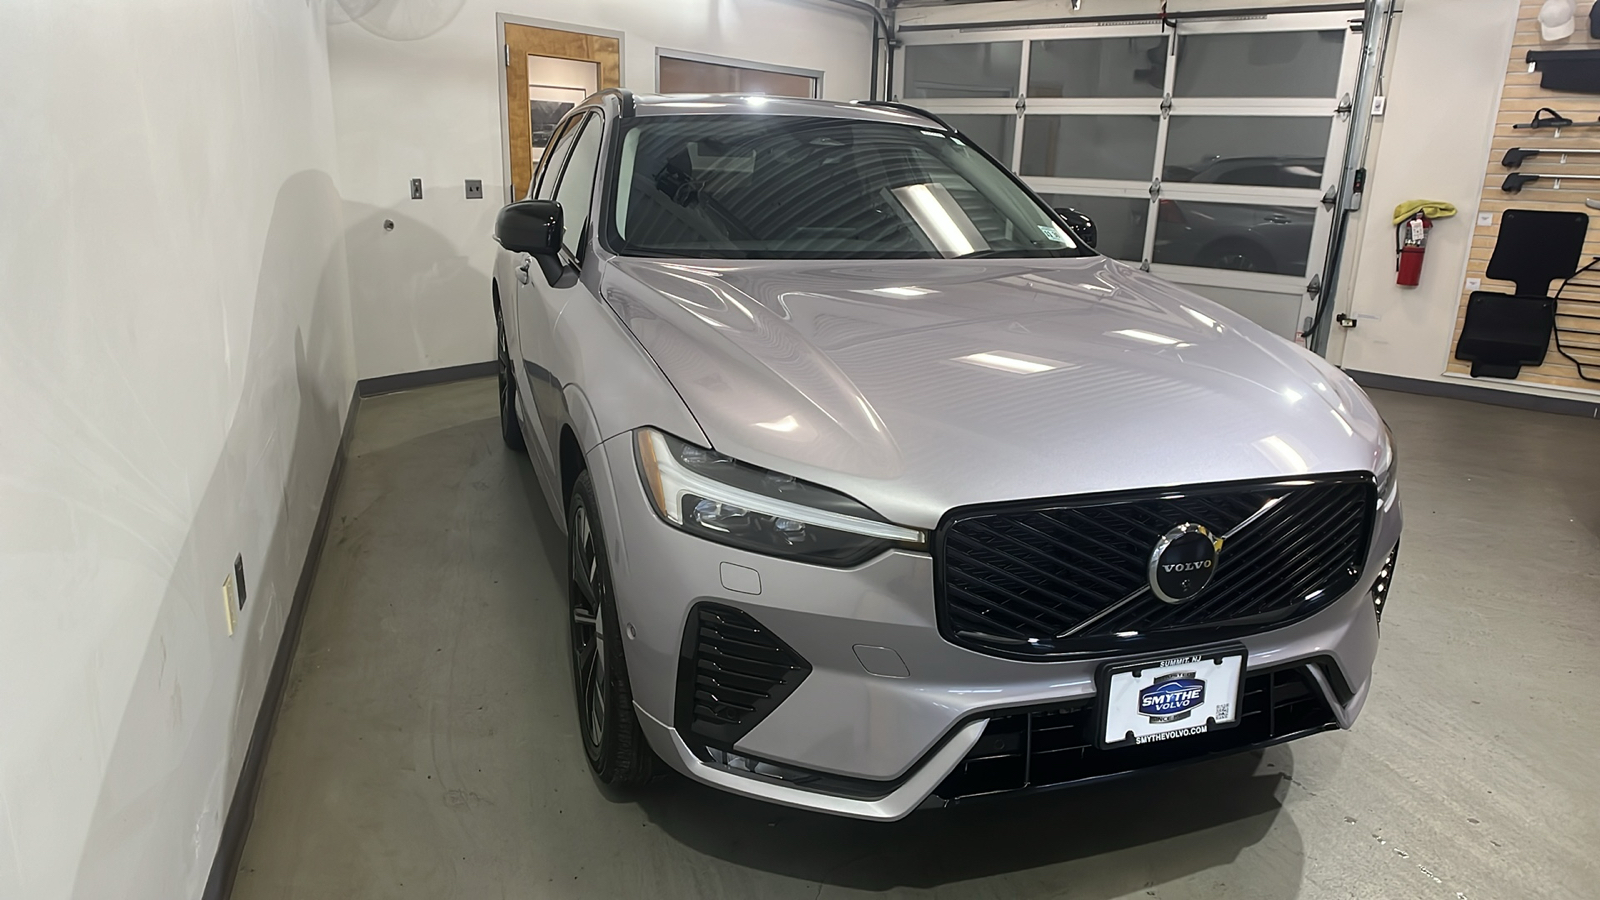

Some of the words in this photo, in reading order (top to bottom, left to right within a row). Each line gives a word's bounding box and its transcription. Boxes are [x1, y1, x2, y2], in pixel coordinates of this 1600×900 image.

[1162, 560, 1211, 572] VOLVO
[1192, 655, 1202, 663] NJ
[1142, 690, 1201, 707] SMYTHE
[1155, 700, 1190, 711] VOLVO
[1135, 725, 1208, 745] SMYTHEVOLVO.COM
